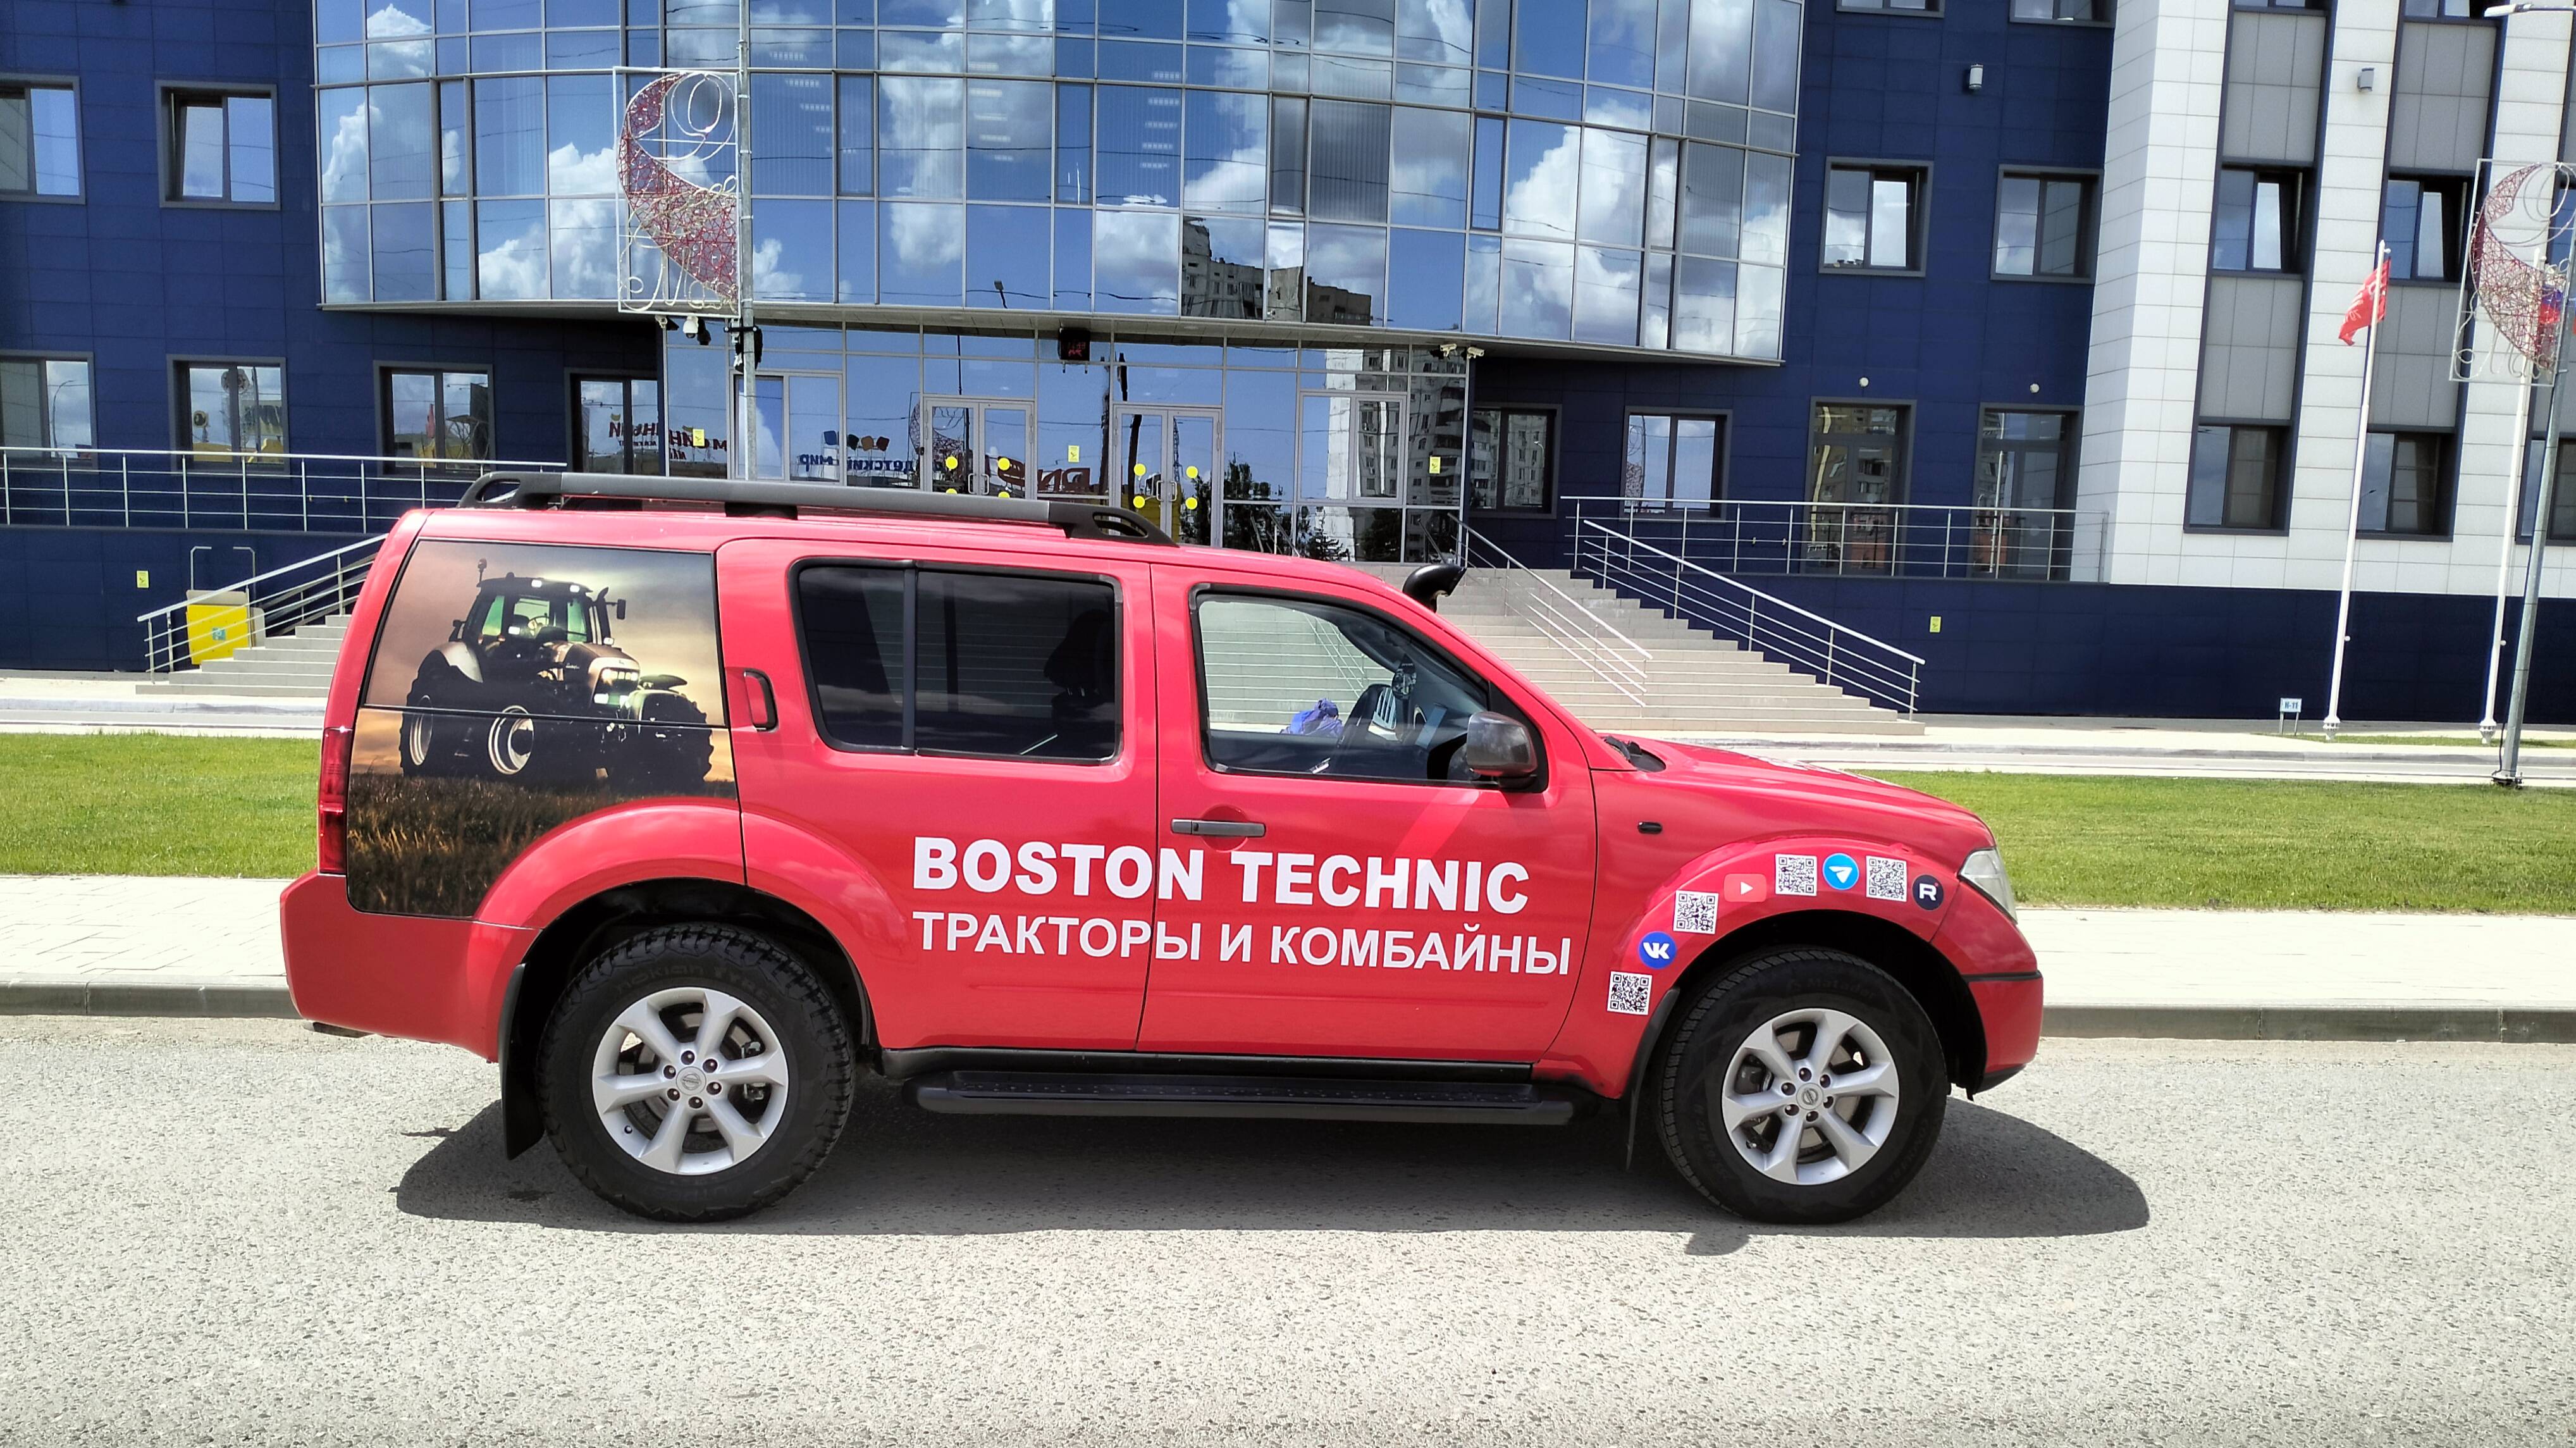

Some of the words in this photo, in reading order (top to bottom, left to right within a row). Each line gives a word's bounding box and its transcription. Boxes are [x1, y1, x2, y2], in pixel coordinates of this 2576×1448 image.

[913, 836, 1204, 901] BOSTON
[1231, 851, 1529, 914] TECHNIC
[912, 911, 1201, 961] ТРАКТОРЫ
[1219, 924, 1253, 962] И
[1270, 923, 1571, 975] КОМБАЙНЫ
